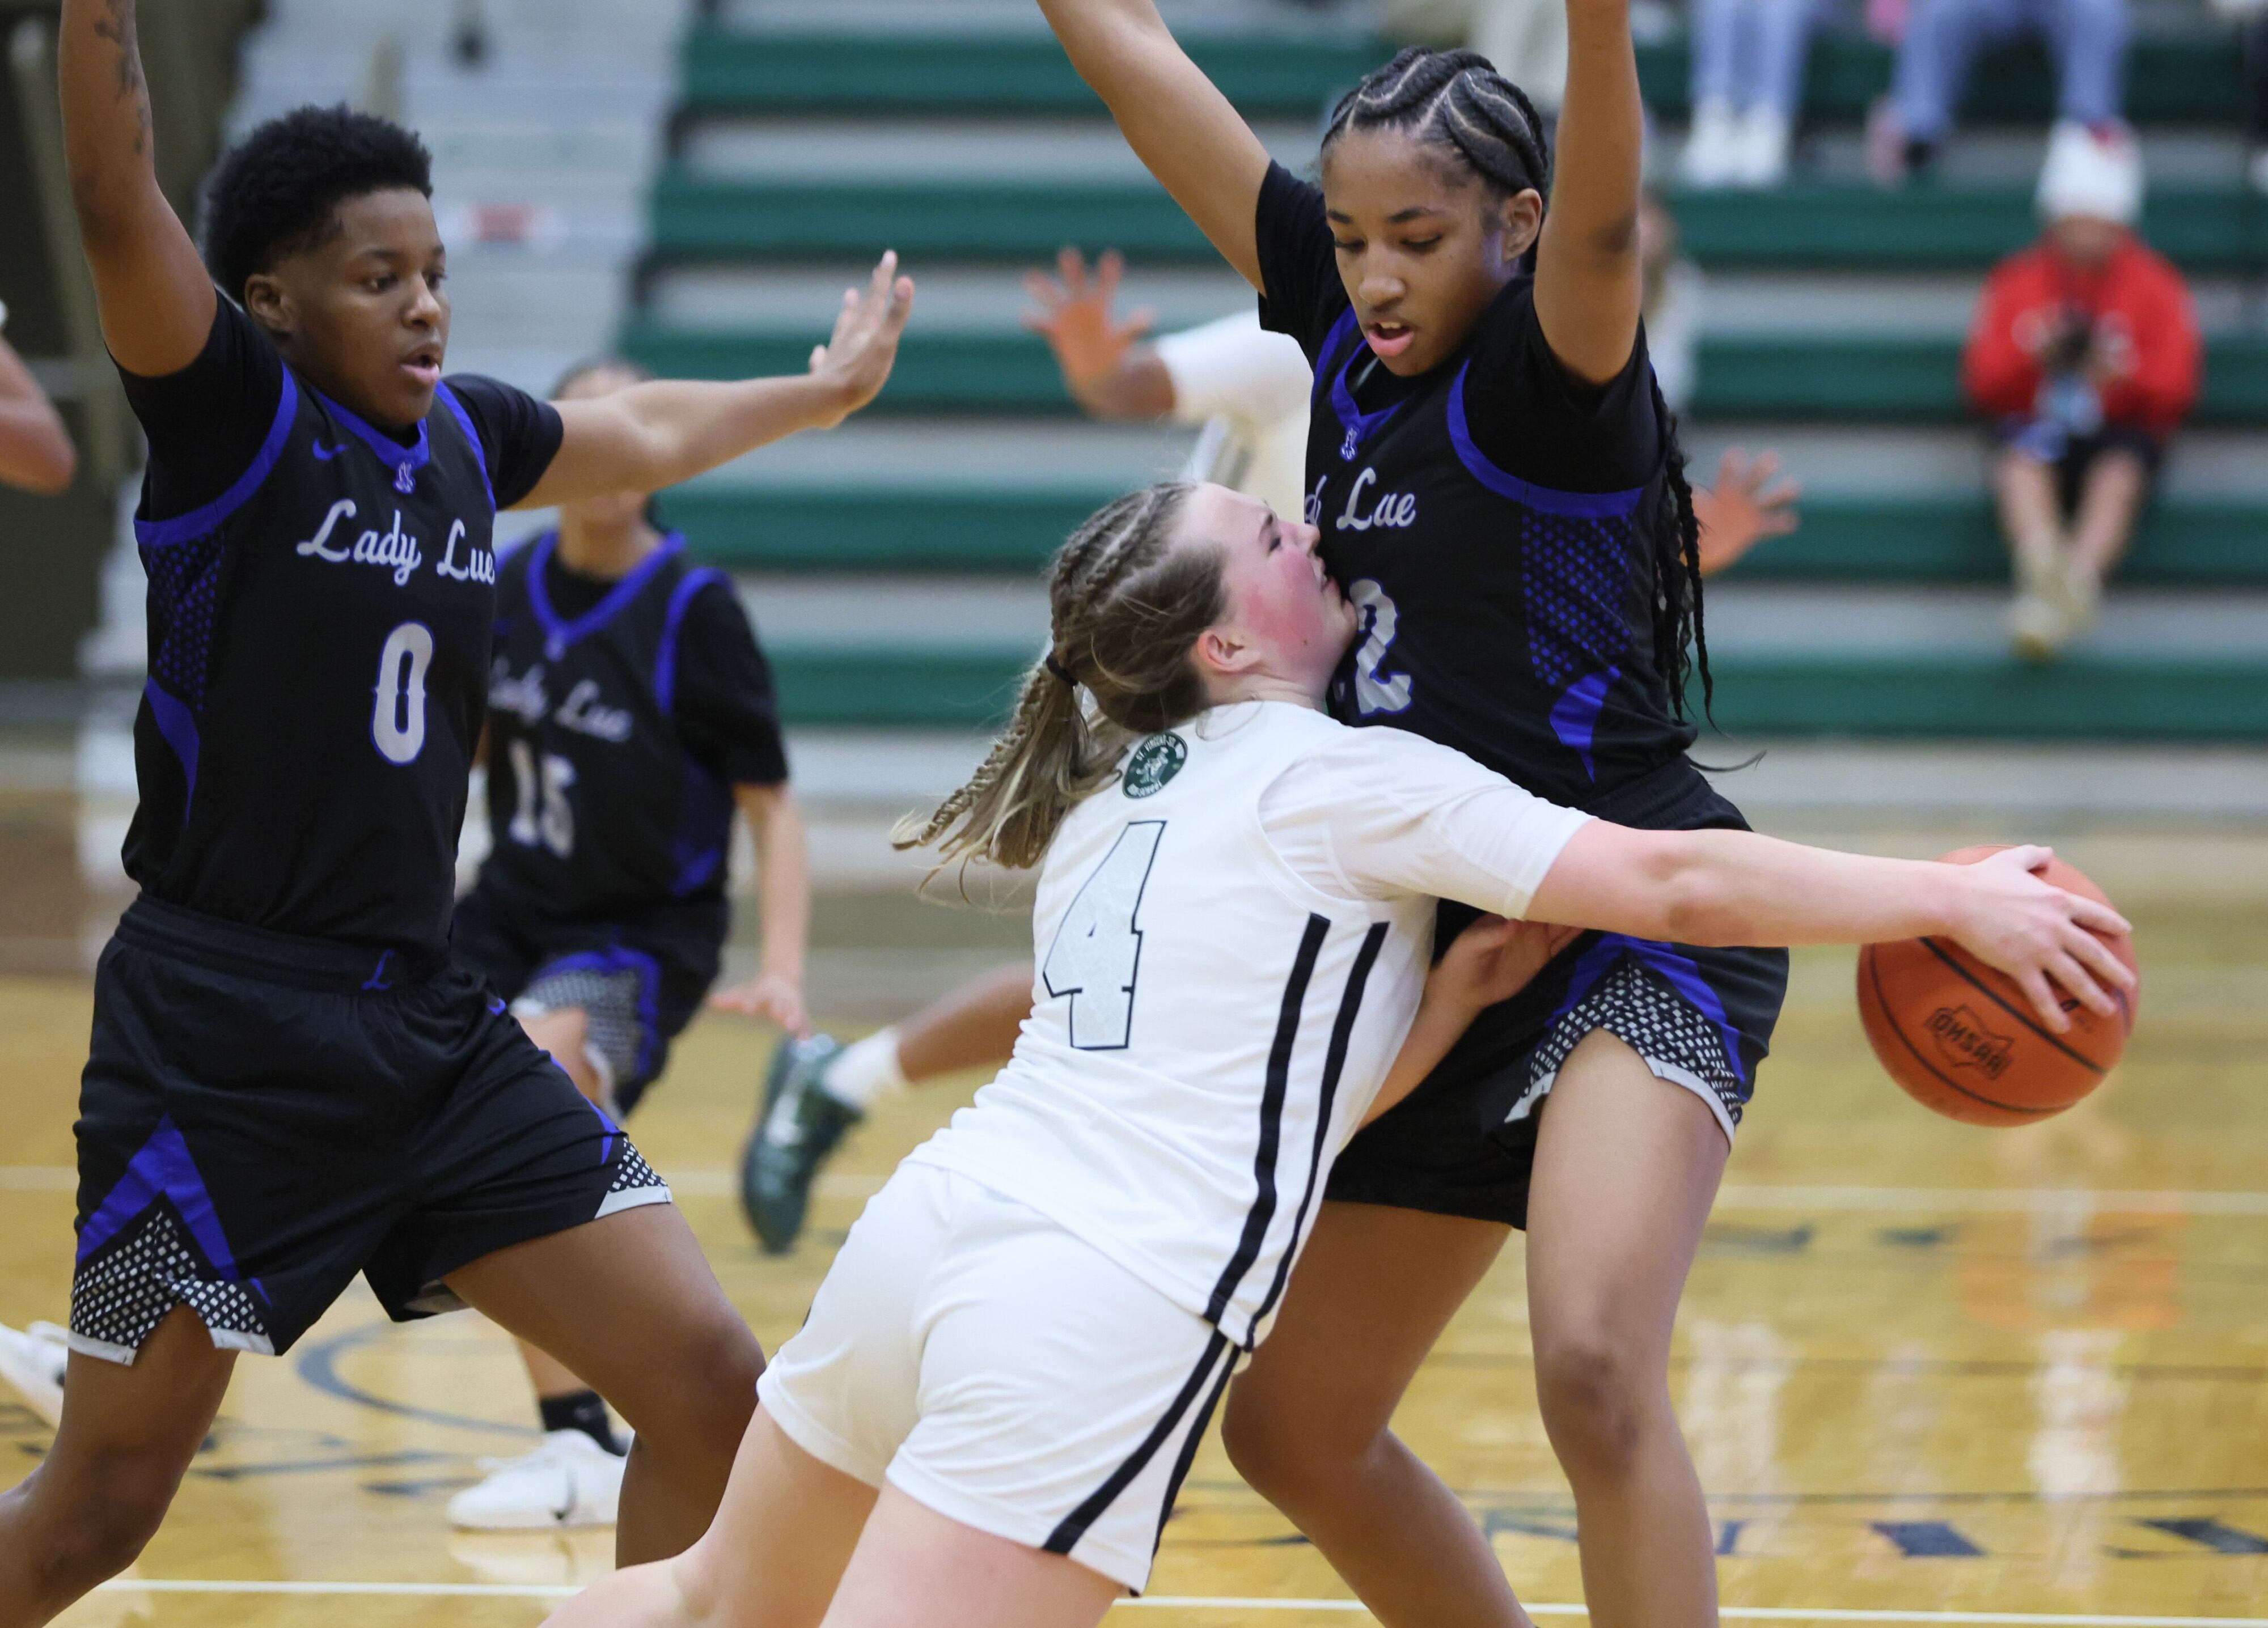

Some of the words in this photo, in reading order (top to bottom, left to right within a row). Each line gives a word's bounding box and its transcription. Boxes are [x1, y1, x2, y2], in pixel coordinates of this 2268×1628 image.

[296, 498, 422, 586] Lady
[1336, 467, 1416, 531] Lue
[370, 622, 435, 766] 0
[507, 738, 578, 859] 15
[1042, 820, 1168, 1051] 4
